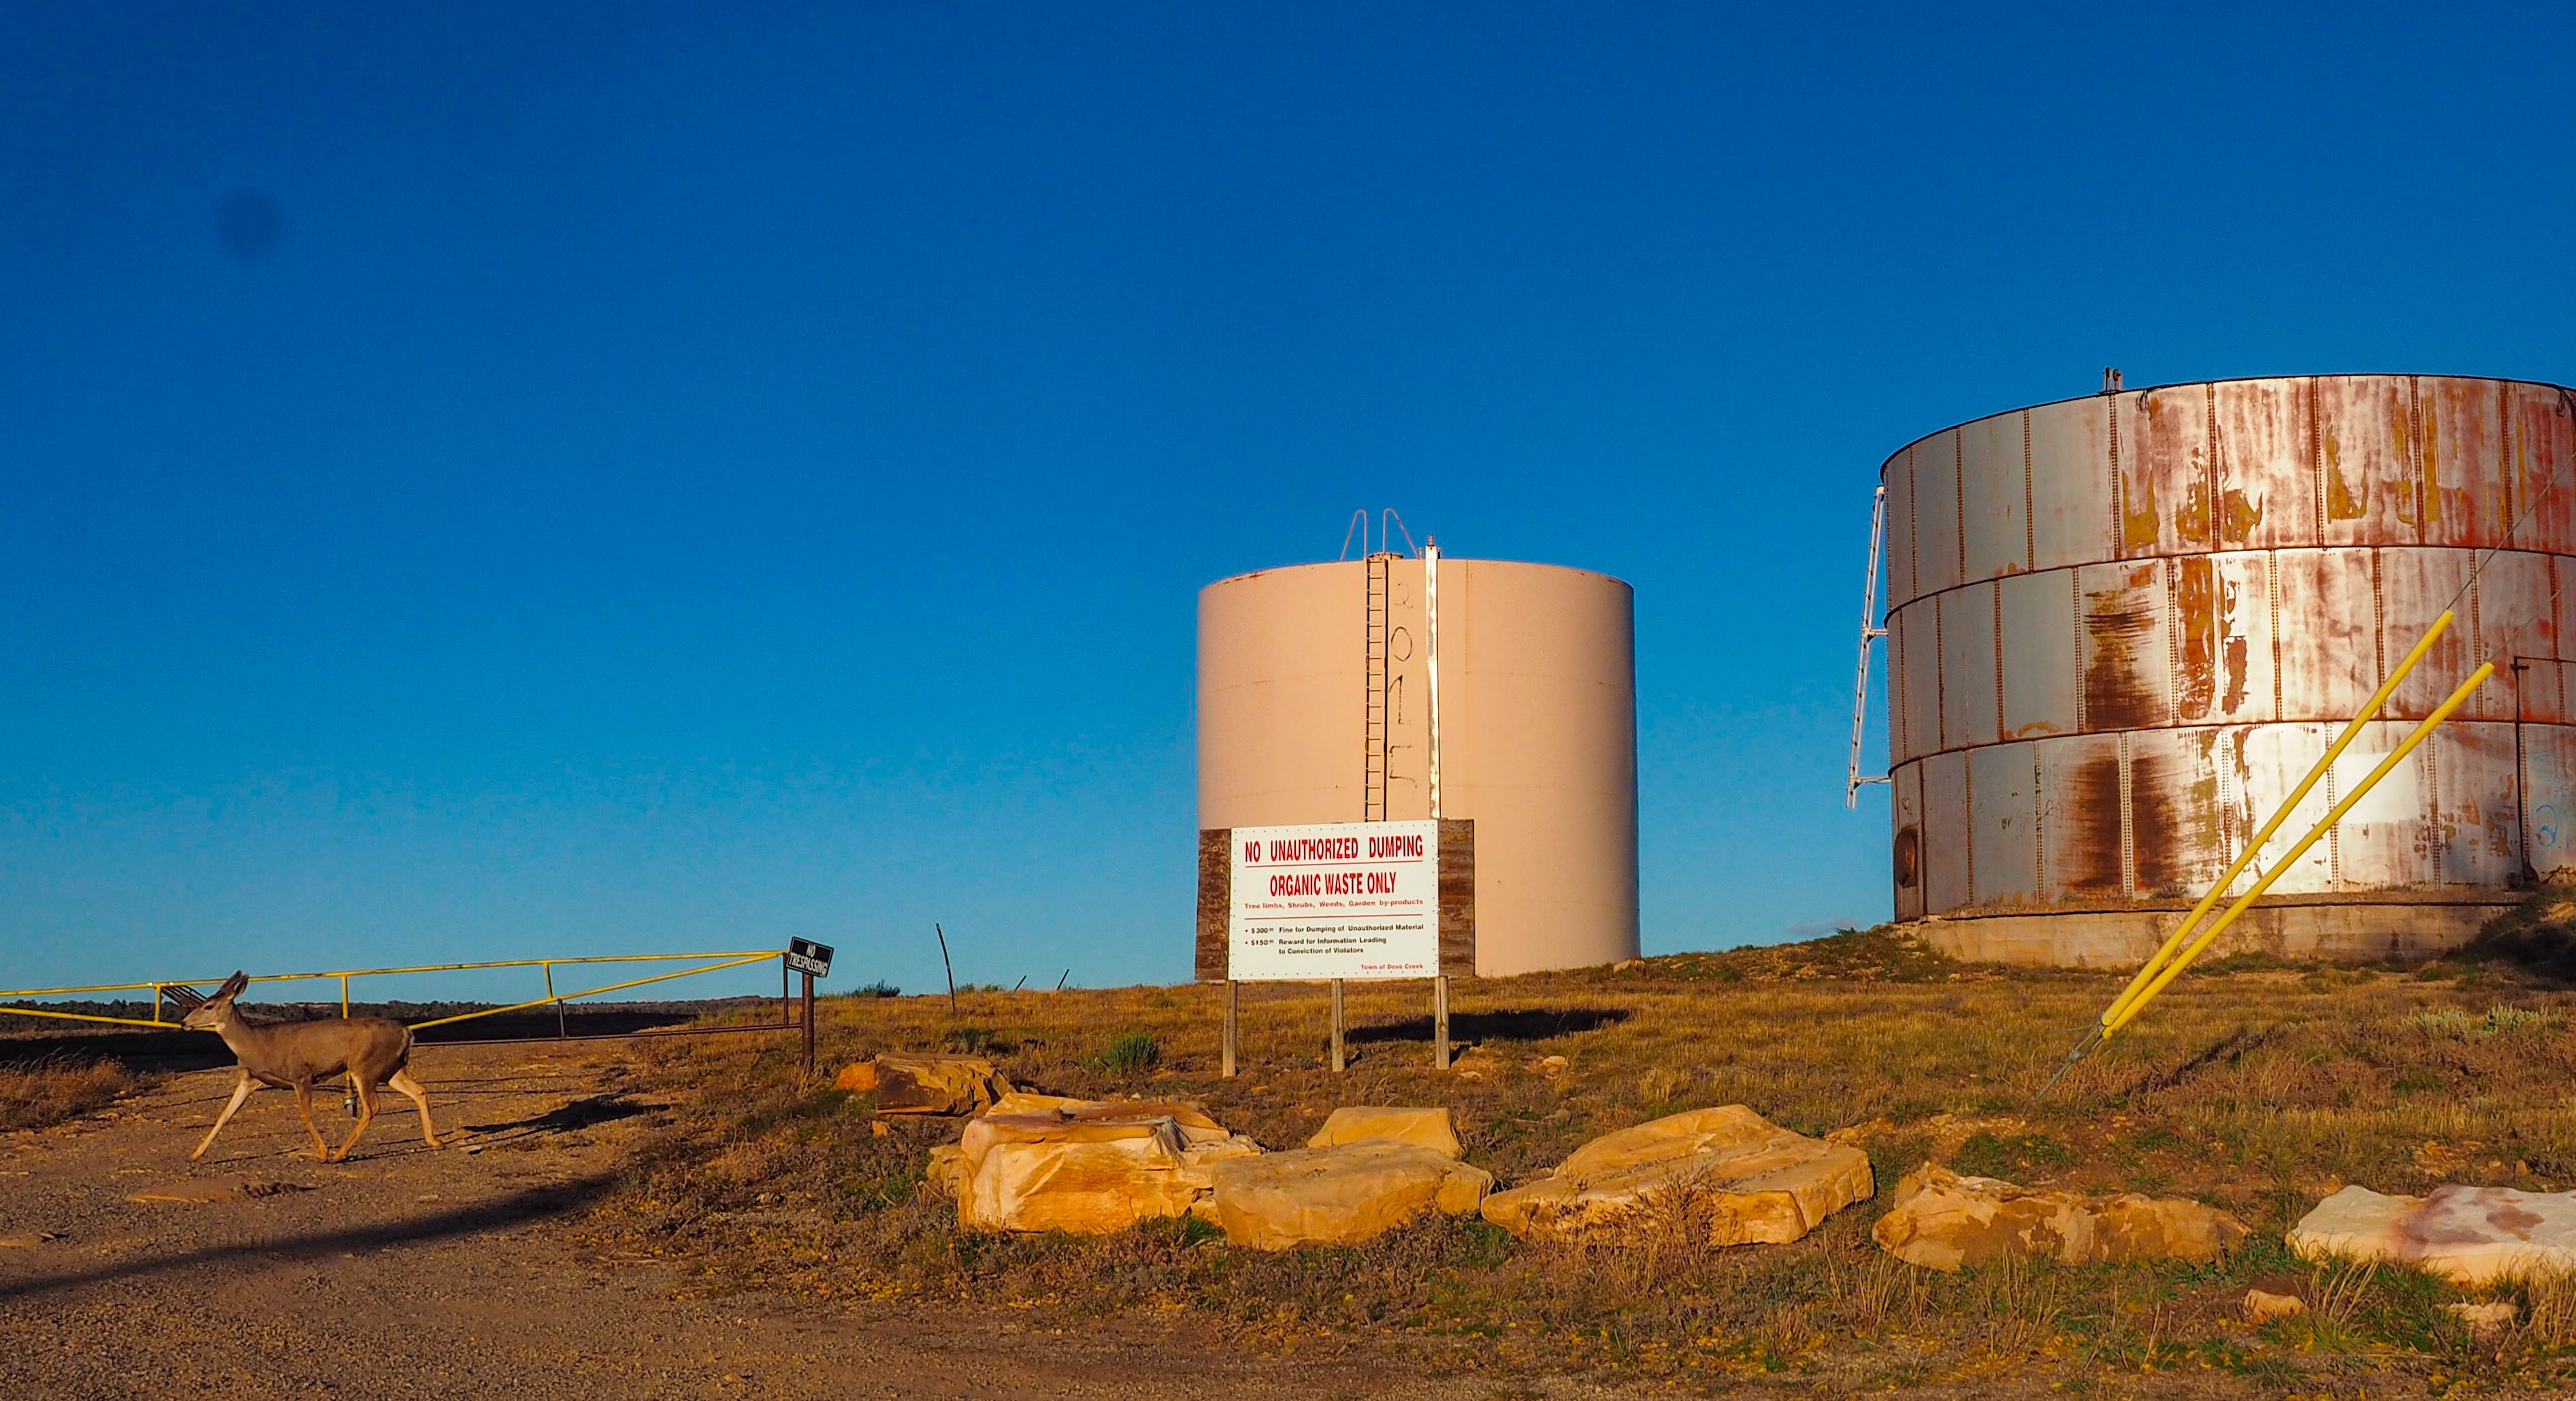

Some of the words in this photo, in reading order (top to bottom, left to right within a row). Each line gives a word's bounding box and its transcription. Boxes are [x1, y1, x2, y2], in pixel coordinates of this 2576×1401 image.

[1245, 841, 1260, 863] NO
[1271, 837, 1358, 862] UNAUTHORIZED
[1369, 835, 1422, 858] DUMPING
[1270, 873, 1321, 897] ORGANIC
[1324, 872, 1363, 895] WASTE
[1367, 871, 1397, 895] ONLY
[1380, 899, 1423, 907] by-products
[806, 944, 817, 958] NO
